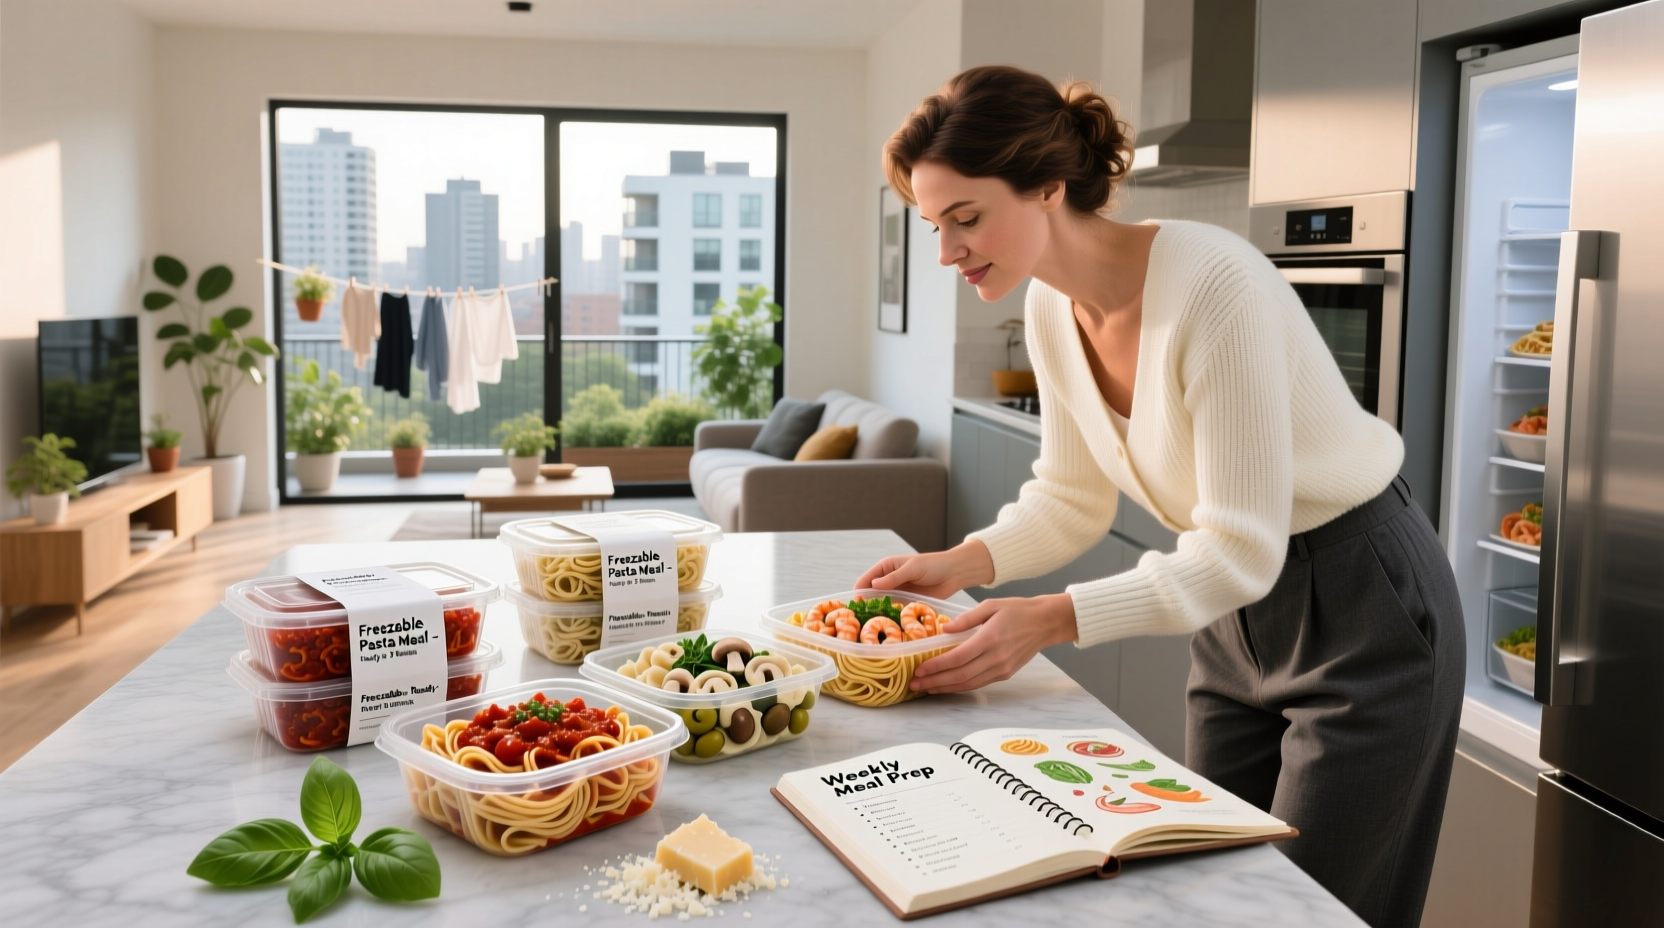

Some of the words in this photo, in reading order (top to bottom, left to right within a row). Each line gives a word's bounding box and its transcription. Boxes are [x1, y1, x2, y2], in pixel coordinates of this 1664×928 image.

[639, 562, 664, 575] Meal
[359, 616, 424, 637] Freezable
[359, 637, 396, 652] Pasta
[399, 630, 429, 646] Meal
[820, 760, 899, 786] Weekly
[834, 776, 884, 797] Meal
[886, 766, 935, 784] Prep
